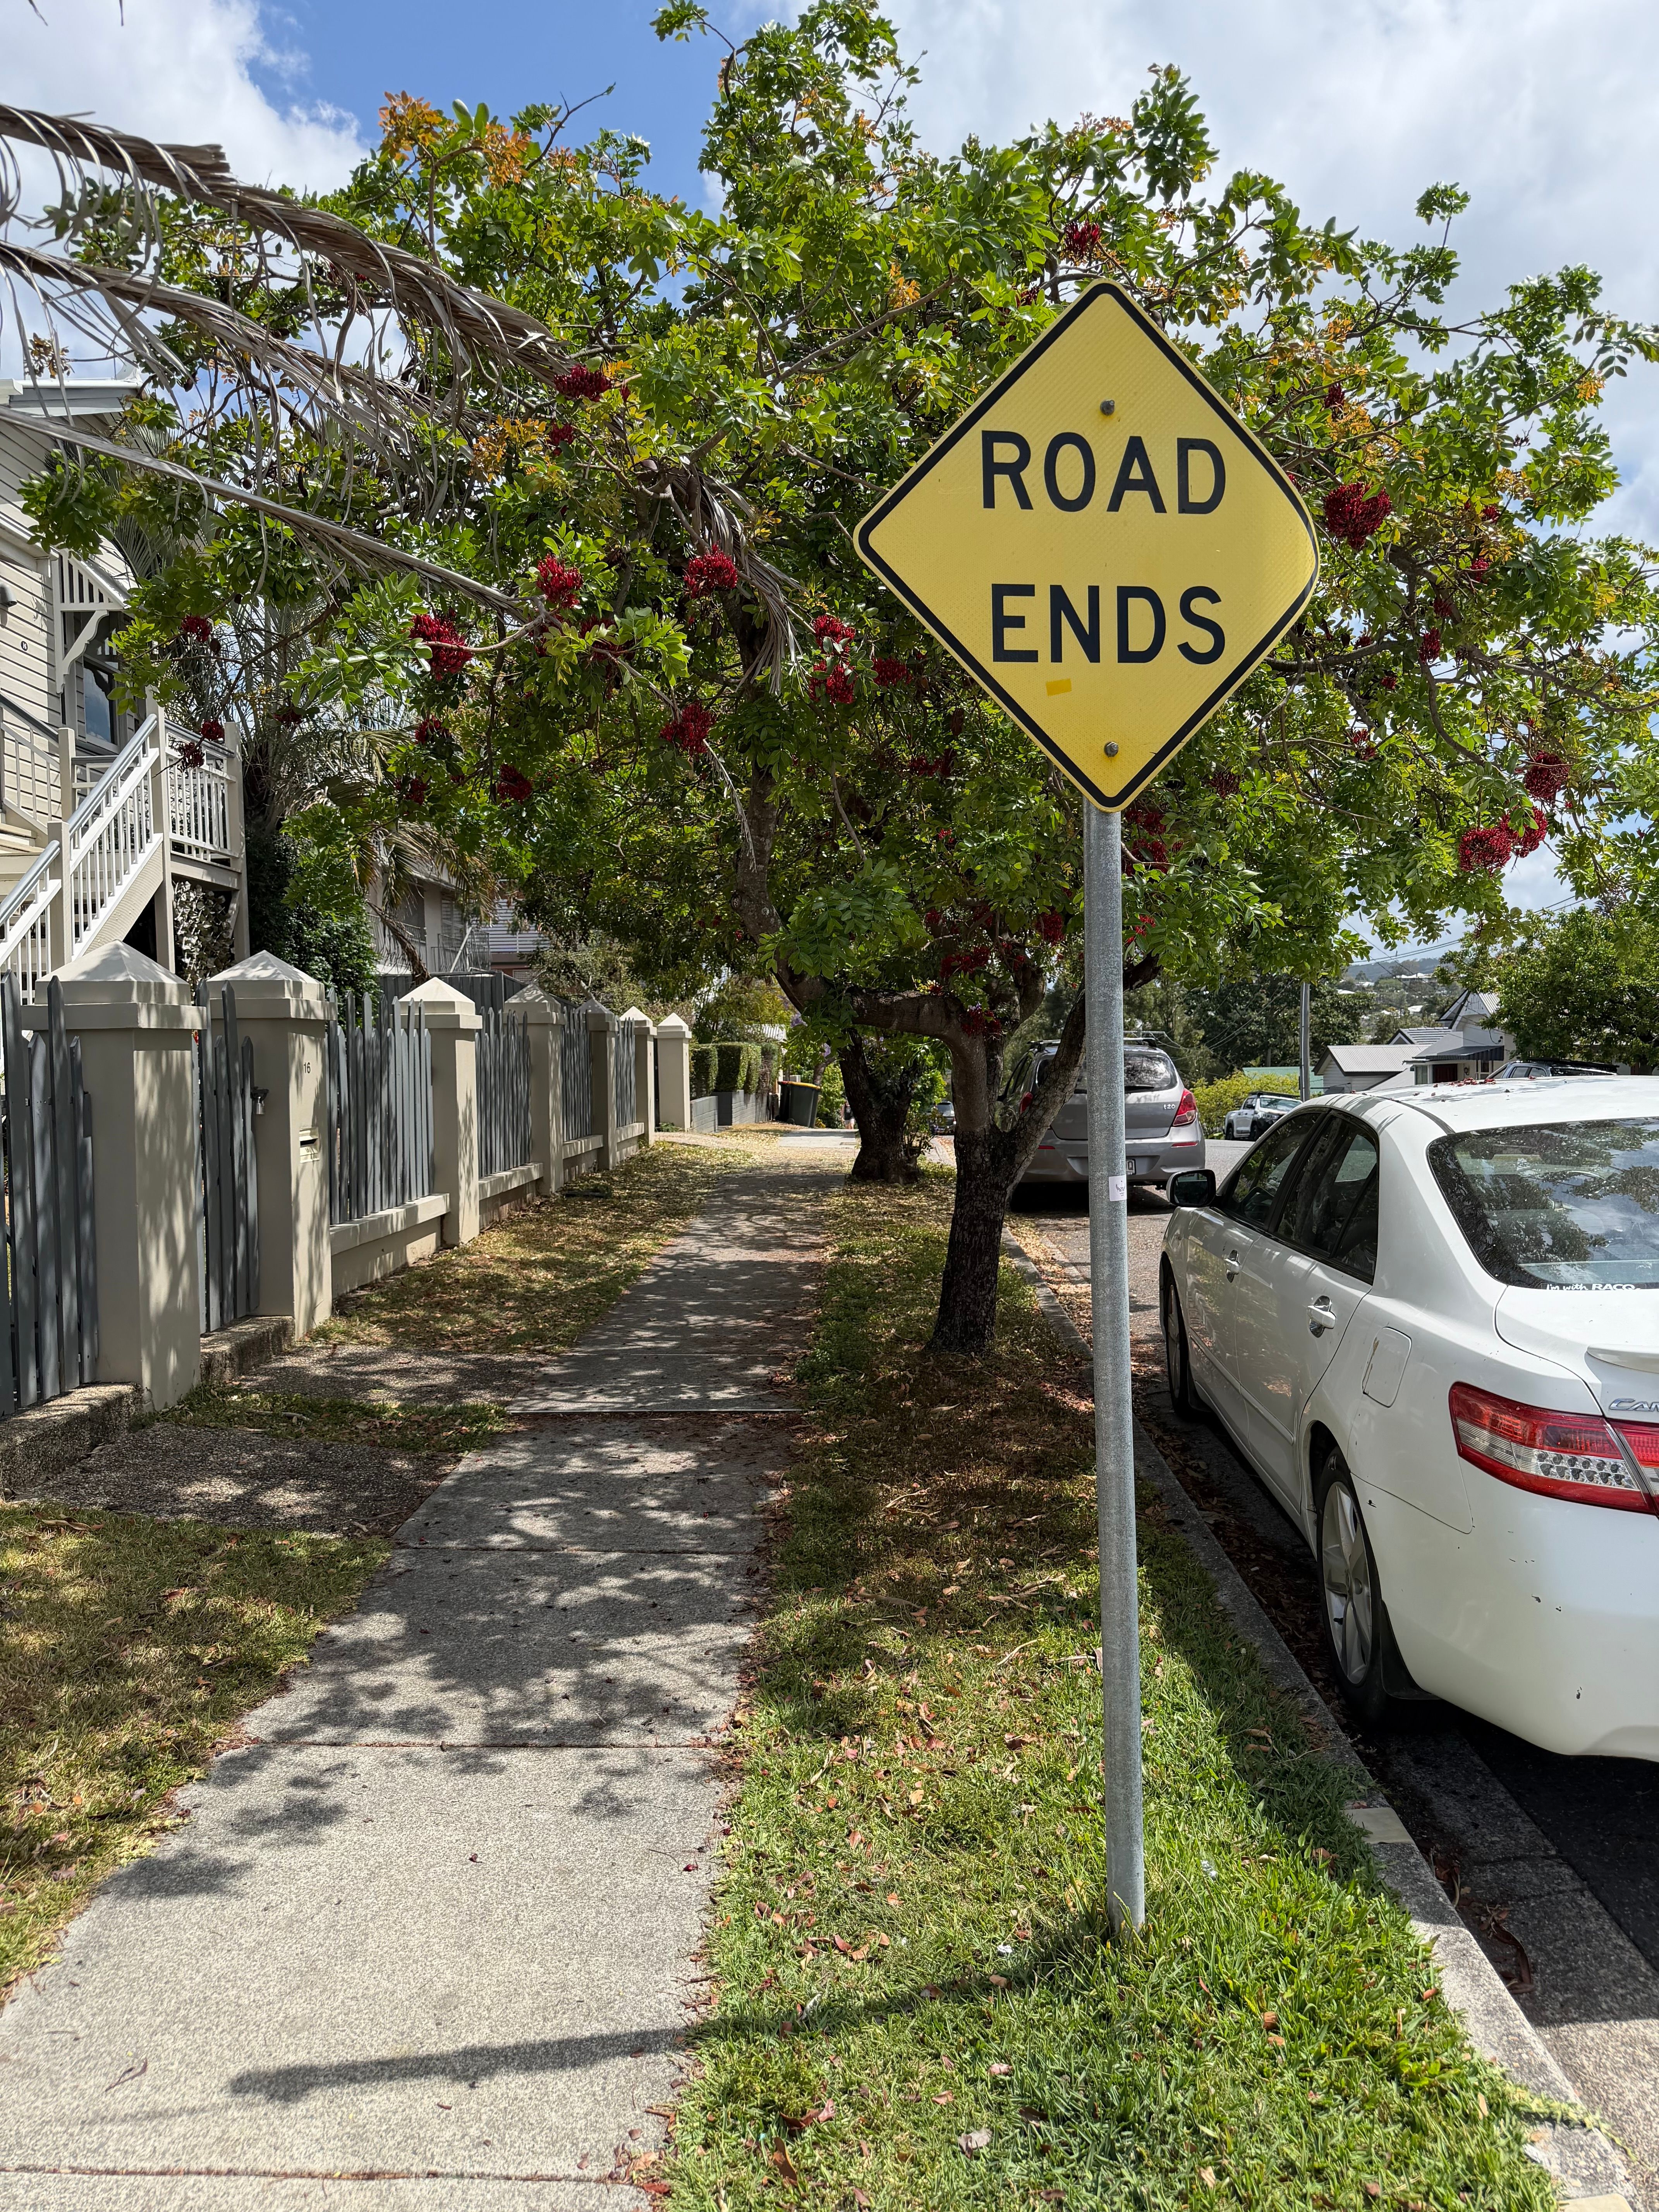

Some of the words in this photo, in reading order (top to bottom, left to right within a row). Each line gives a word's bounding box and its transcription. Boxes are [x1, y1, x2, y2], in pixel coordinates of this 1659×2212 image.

[982, 430, 1226, 514] ROAD
[991, 584, 1225, 665] ENDS
[304, 1062, 311, 1073] 16
